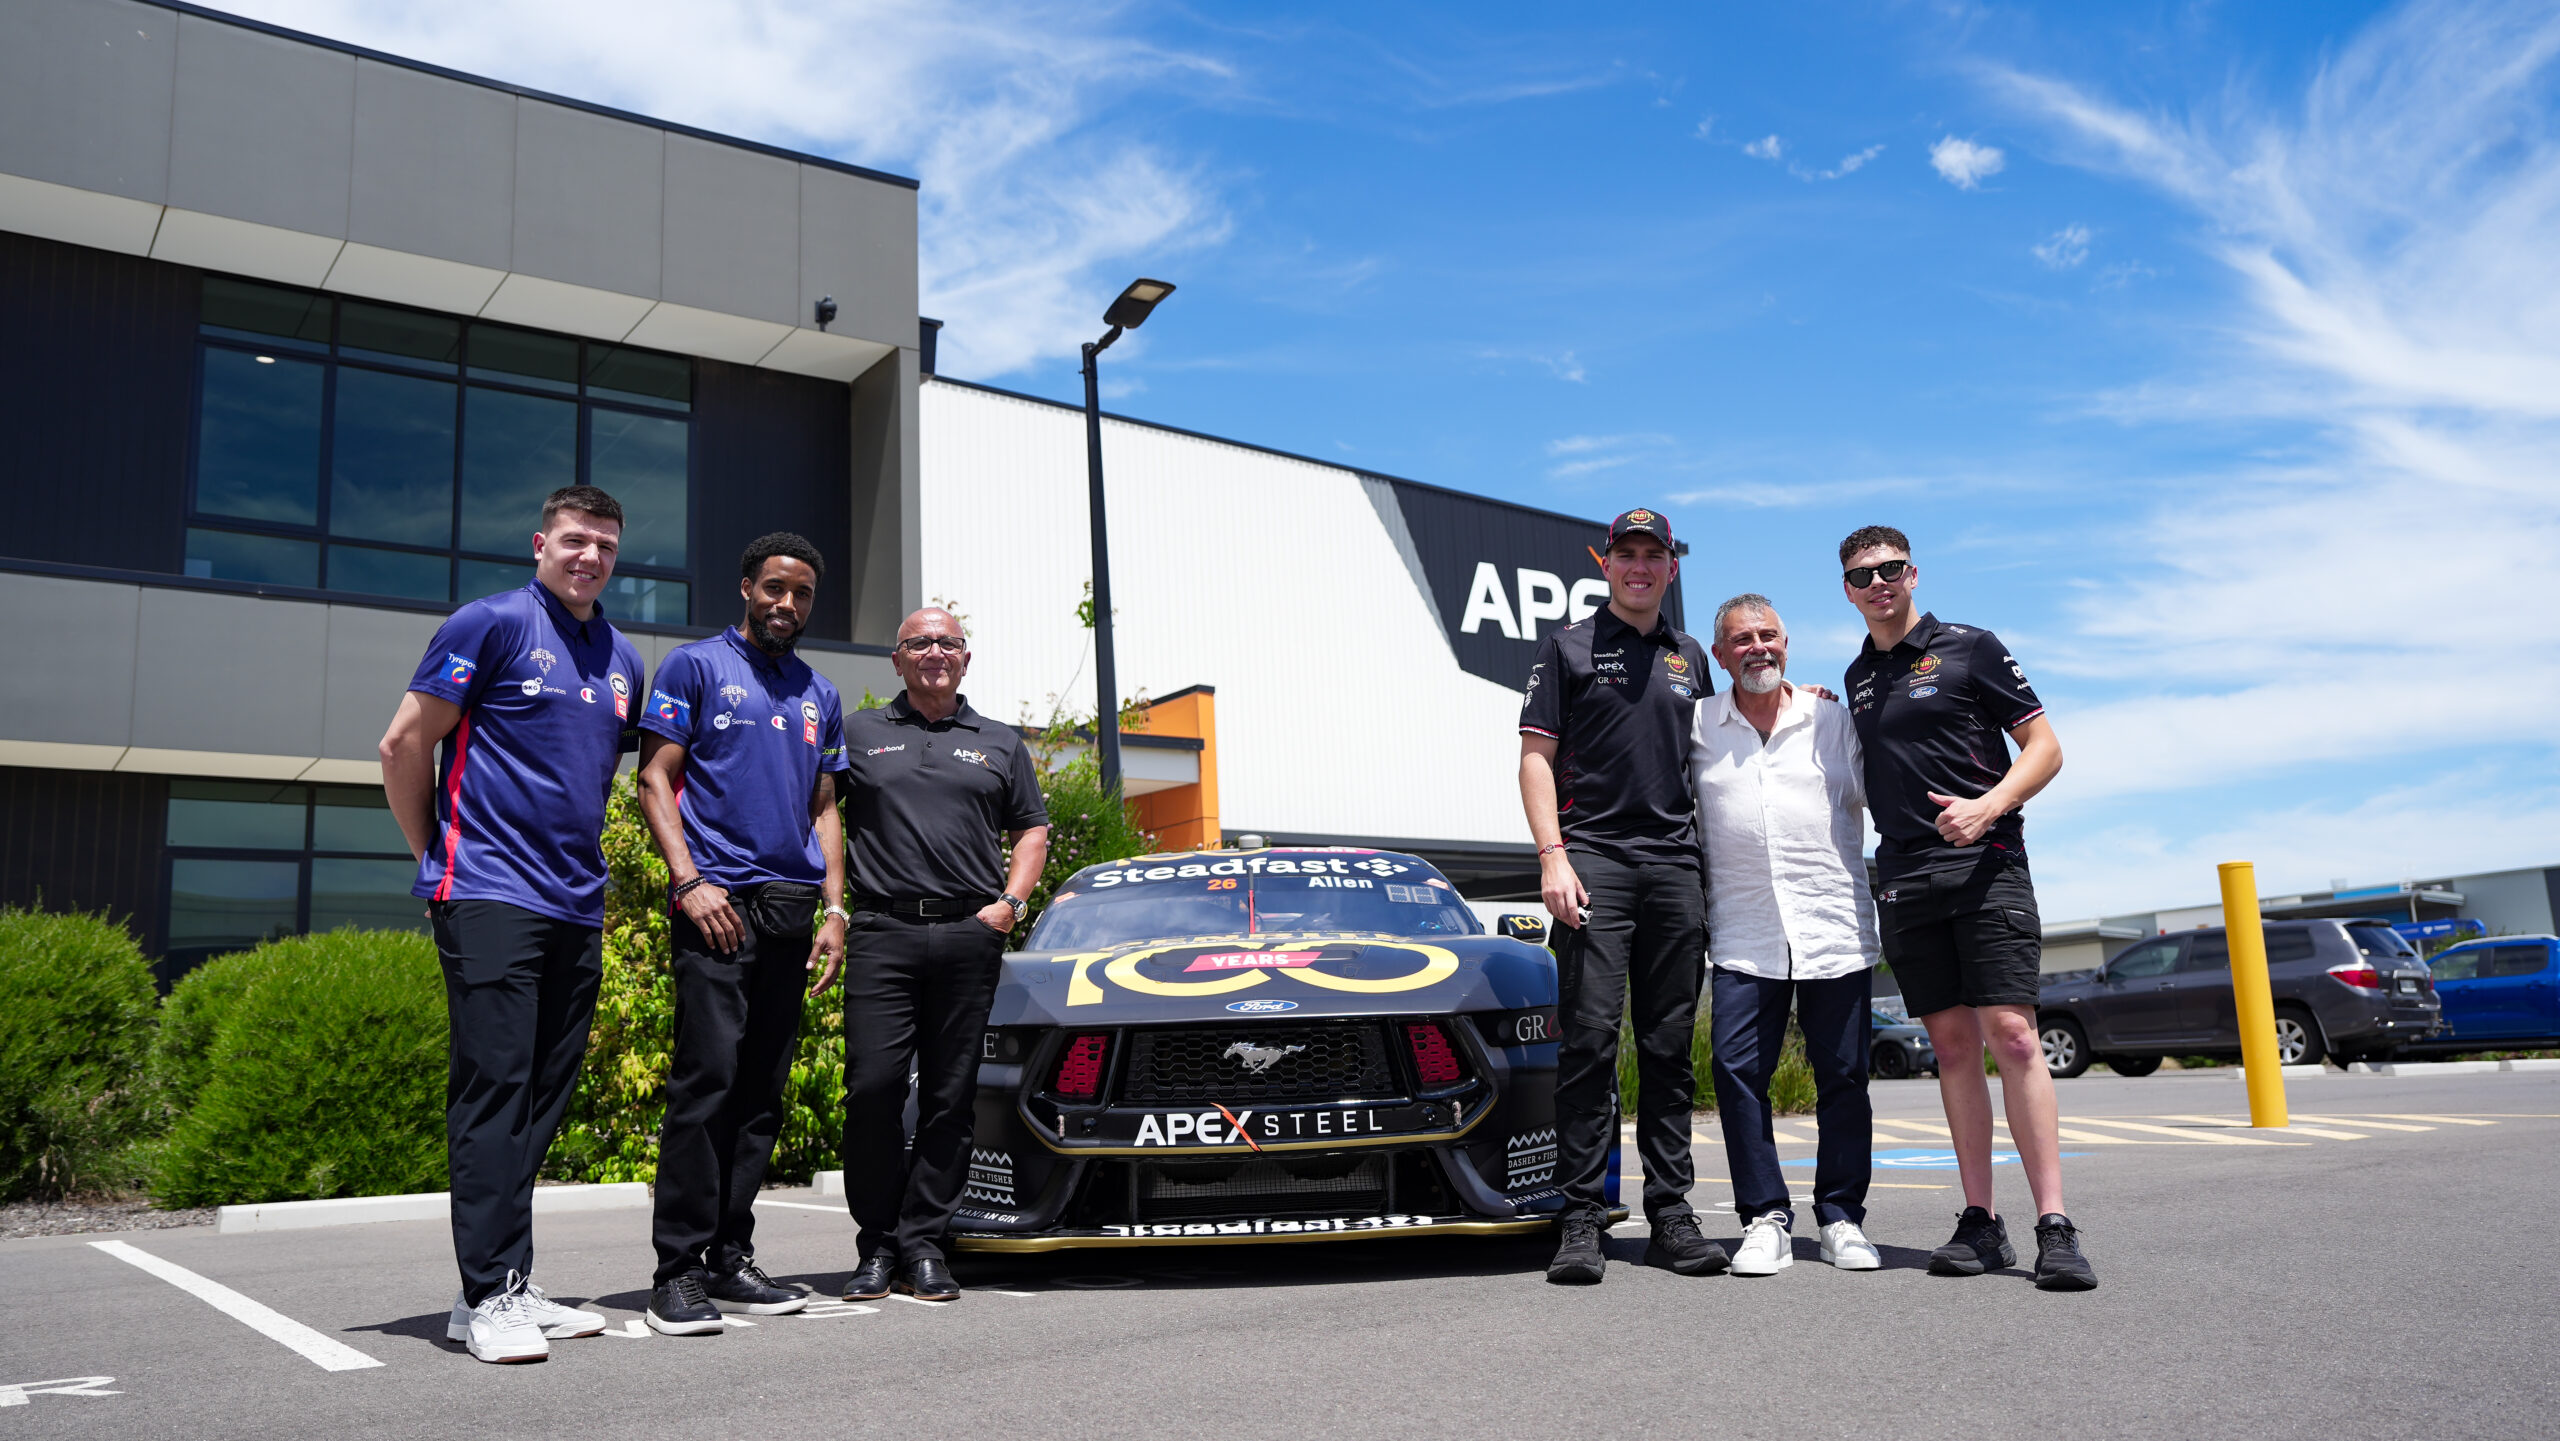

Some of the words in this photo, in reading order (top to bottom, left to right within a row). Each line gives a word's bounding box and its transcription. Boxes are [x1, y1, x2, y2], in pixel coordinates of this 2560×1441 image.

[1460, 555, 1612, 642] APE
[1597, 661, 1627, 672] APEX
[1911, 658, 1942, 671] PENRITE
[1597, 676, 1629, 685] GROVE
[542, 685, 567, 695] Services
[654, 689, 691, 710] Tyrepower
[731, 718, 756, 726] Services
[867, 744, 905, 756] Colorbond
[953, 748, 989, 766] APEX
[1091, 857, 1350, 888] Steadfast
[1207, 878, 1238, 891] 26
[1308, 875, 1374, 889] Allen
[1509, 916, 1543, 931] 100
[1210, 953, 1289, 967] YEARS
[1134, 1103, 1263, 1151] APEX
[1264, 1109, 1383, 1137] STEEL
[1508, 1155, 1537, 1169] DASHER
[986, 1173, 1013, 1185] FISHER
[1505, 1188, 1560, 1208] TASMANIA
[997, 1213, 1020, 1224] GIN
